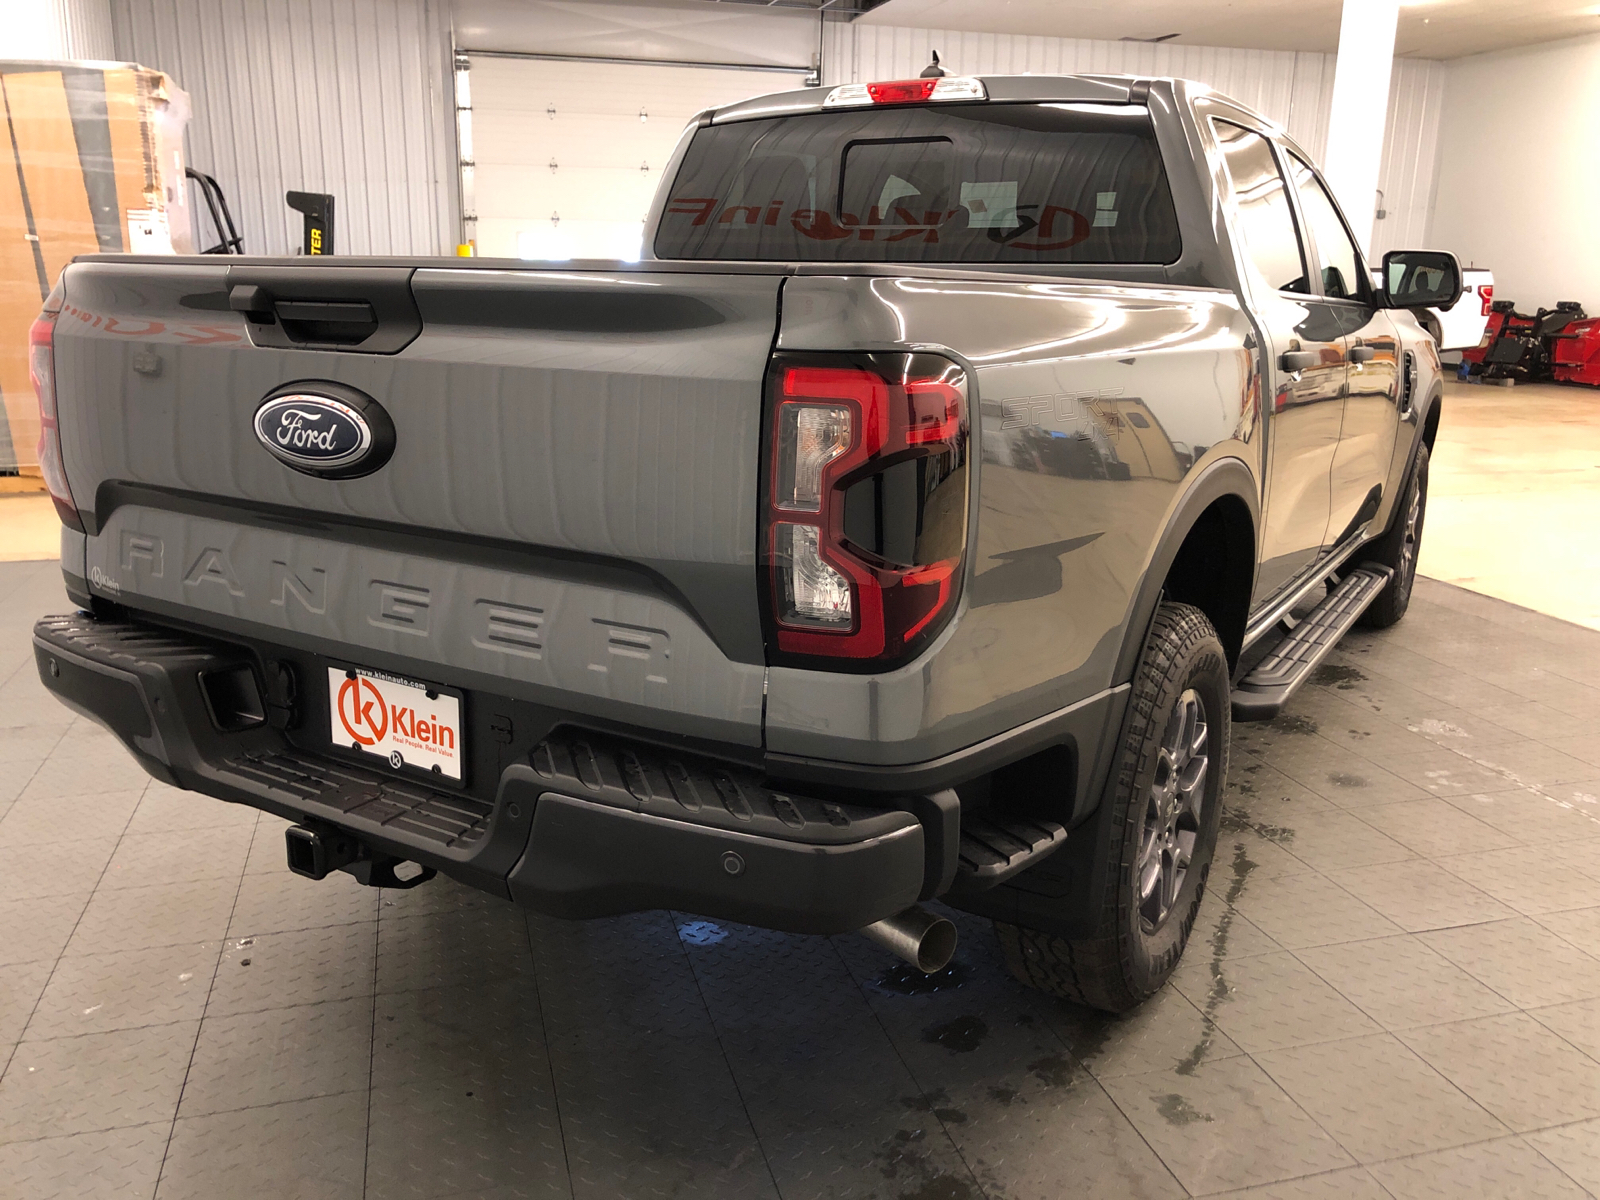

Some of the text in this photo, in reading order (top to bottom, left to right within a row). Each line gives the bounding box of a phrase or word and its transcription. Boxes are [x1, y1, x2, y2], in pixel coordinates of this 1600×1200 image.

[276, 409, 337, 450] Ford
[1001, 387, 1124, 430] SPORT
[120, 529, 671, 684] RANGER
[355, 667, 427, 690] www.kleinauto.com
[391, 703, 455, 749] Klein
[392, 735, 405, 744] Real
[425, 744, 438, 753] Real
